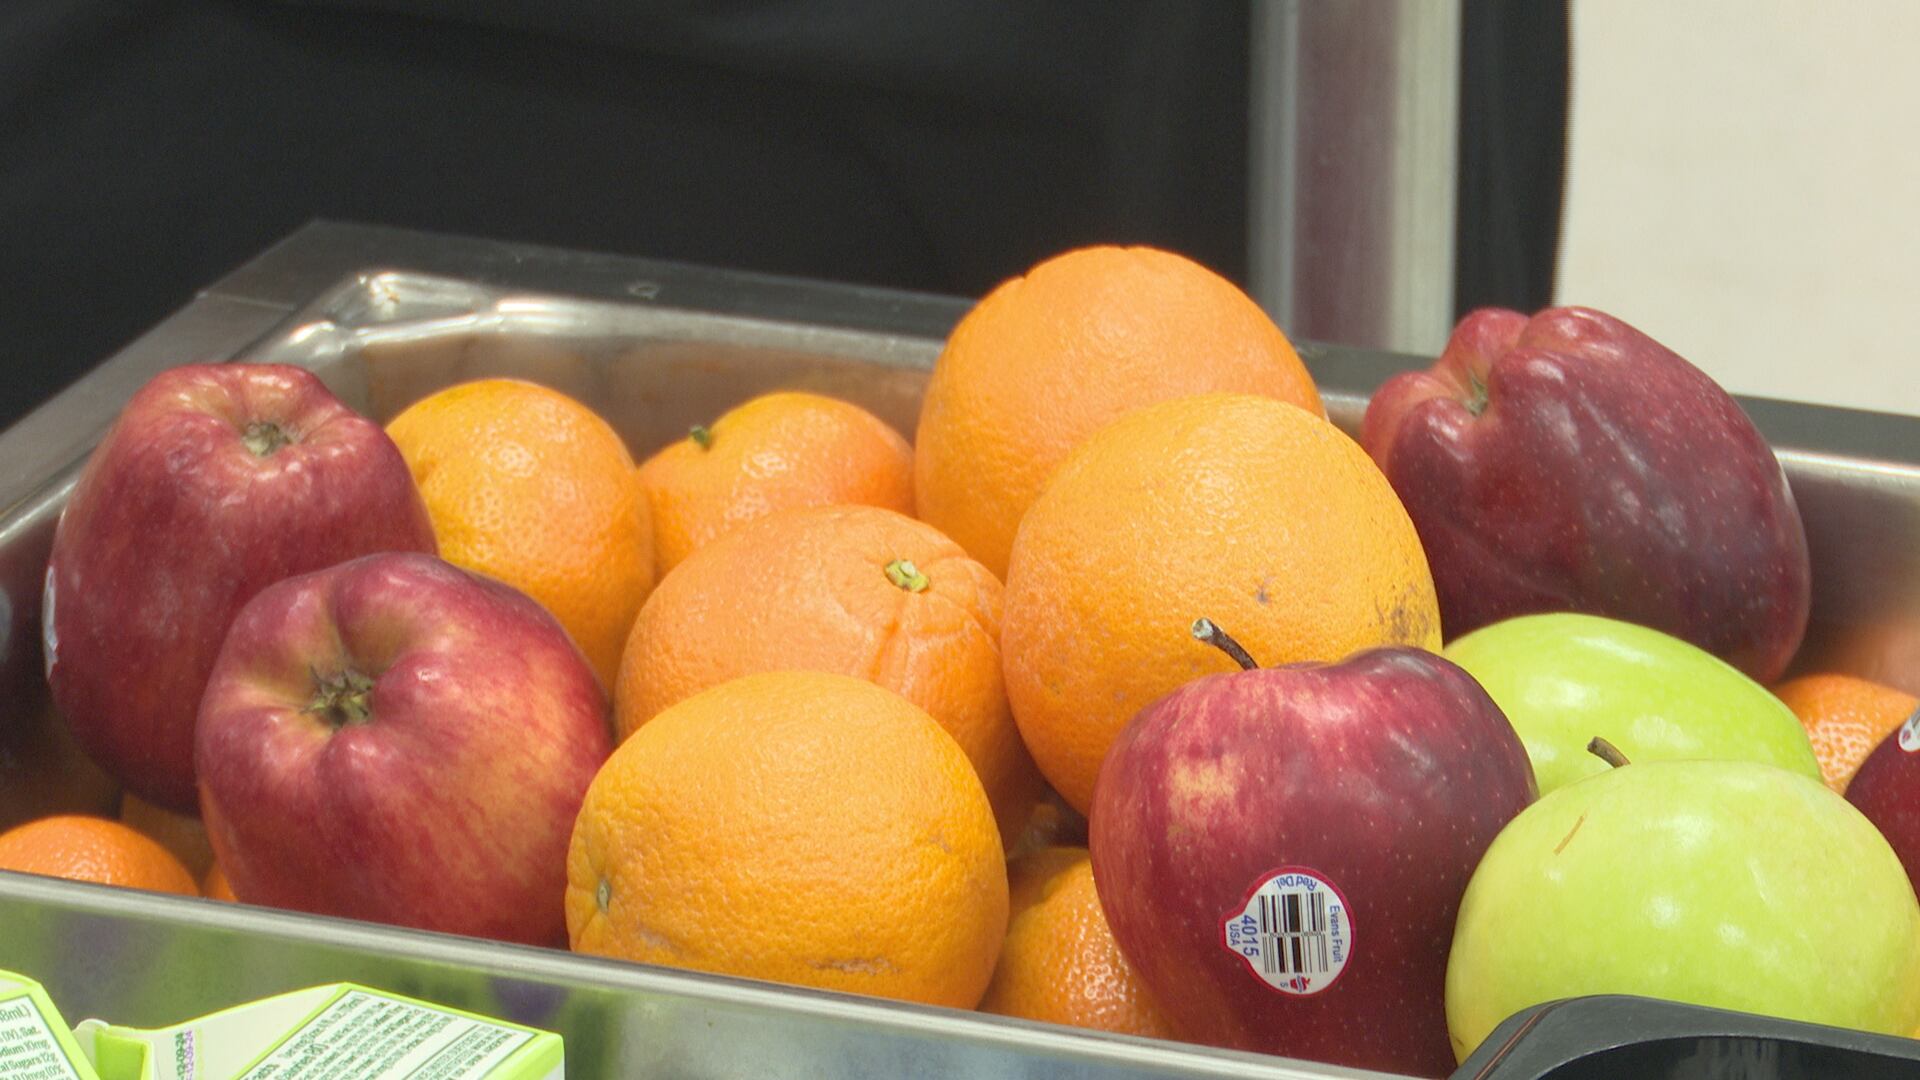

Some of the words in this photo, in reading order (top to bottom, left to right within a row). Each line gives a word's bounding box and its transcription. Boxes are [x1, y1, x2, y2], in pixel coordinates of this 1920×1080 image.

[1274, 875, 1294, 889] Del.
[1296, 875, 1317, 891] Red
[1329, 905, 1341, 937] Evans
[1229, 924, 1241, 946] USA
[1241, 915, 1259, 957] 4015
[1332, 938, 1344, 963] Fruit
[9, 1057, 41, 1070] Sugars
